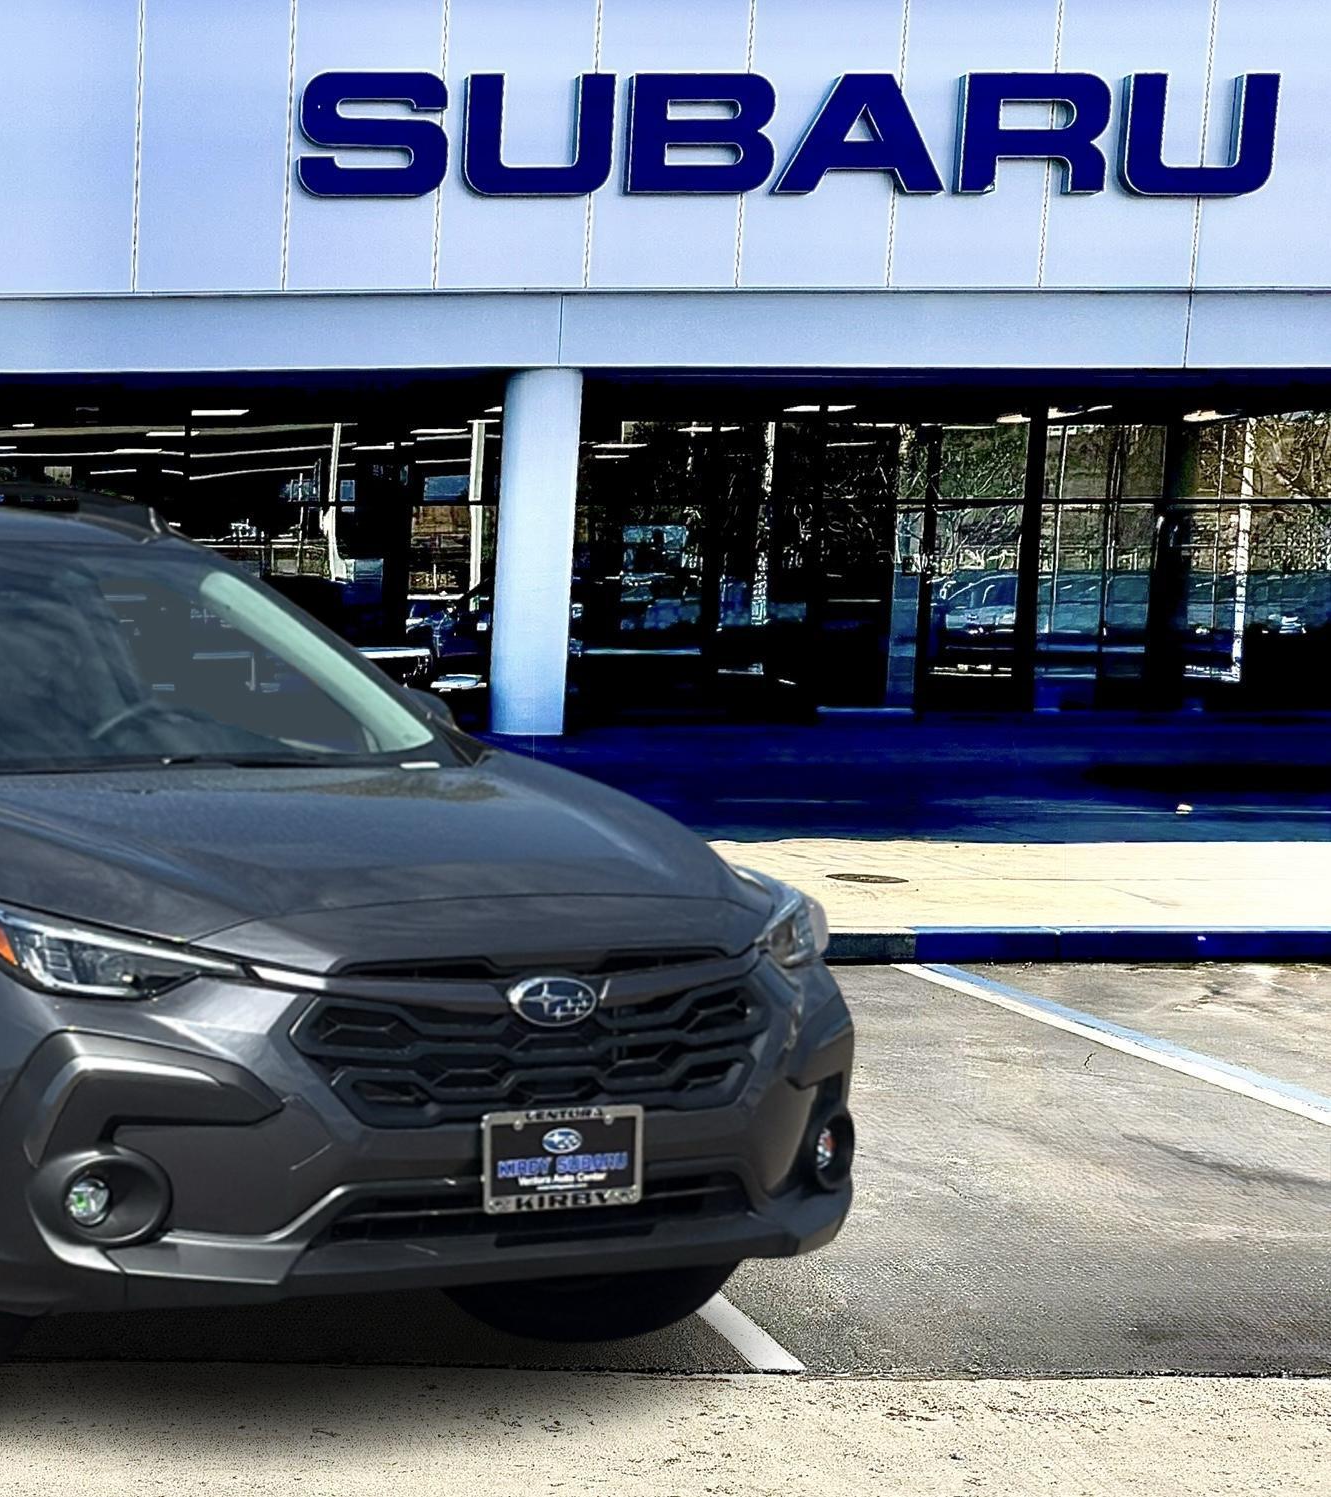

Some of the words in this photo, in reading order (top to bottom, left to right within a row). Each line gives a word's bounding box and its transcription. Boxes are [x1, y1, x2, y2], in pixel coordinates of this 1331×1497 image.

[297, 71, 1282, 198] SUBARU
[497, 1157, 552, 1178] KIRBY
[556, 1152, 628, 1174] SUBARU
[515, 1190, 611, 1210] KIRBY
